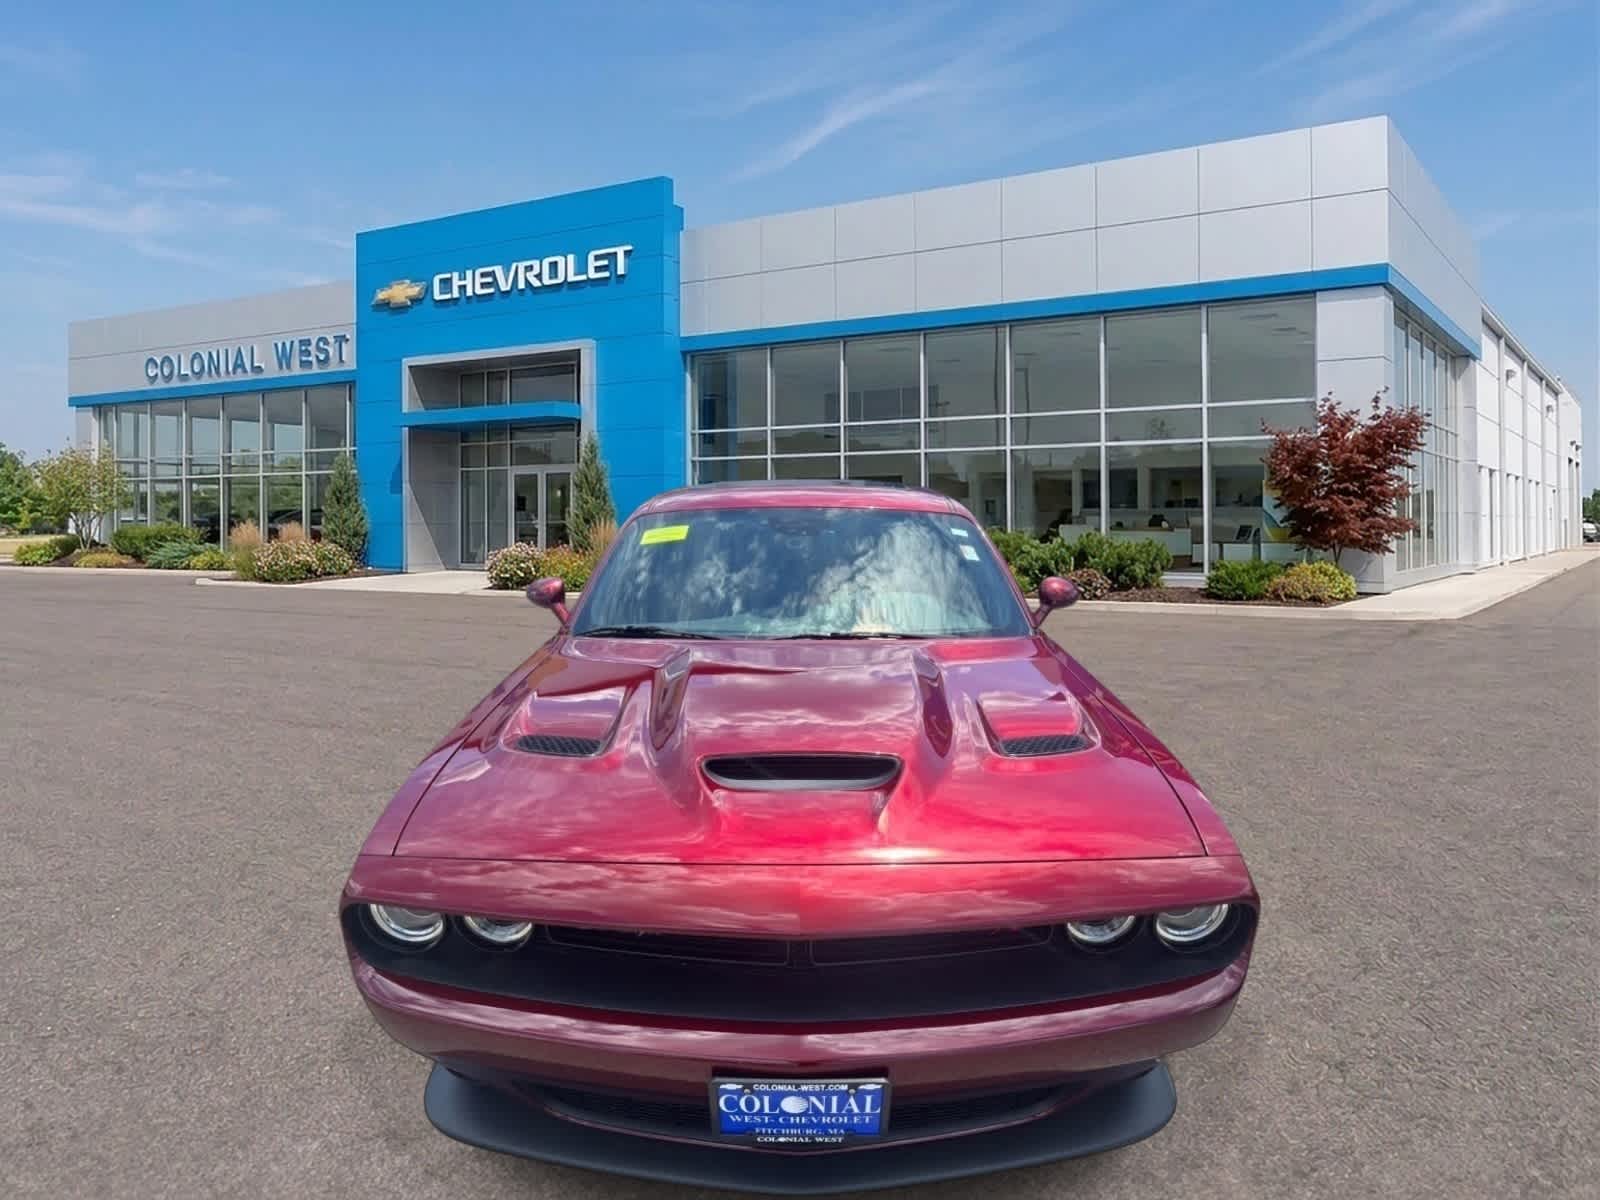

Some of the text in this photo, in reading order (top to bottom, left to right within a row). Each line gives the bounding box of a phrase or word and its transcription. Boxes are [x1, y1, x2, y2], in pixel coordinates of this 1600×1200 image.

[432, 245, 634, 302] CHEVROLET
[145, 334, 350, 384] COLONIAL WEST
[753, 1084, 849, 1092] COLONIAL-WEST.COM
[719, 1094, 881, 1114] COLONIAL
[815, 1136, 845, 1144] WEST
